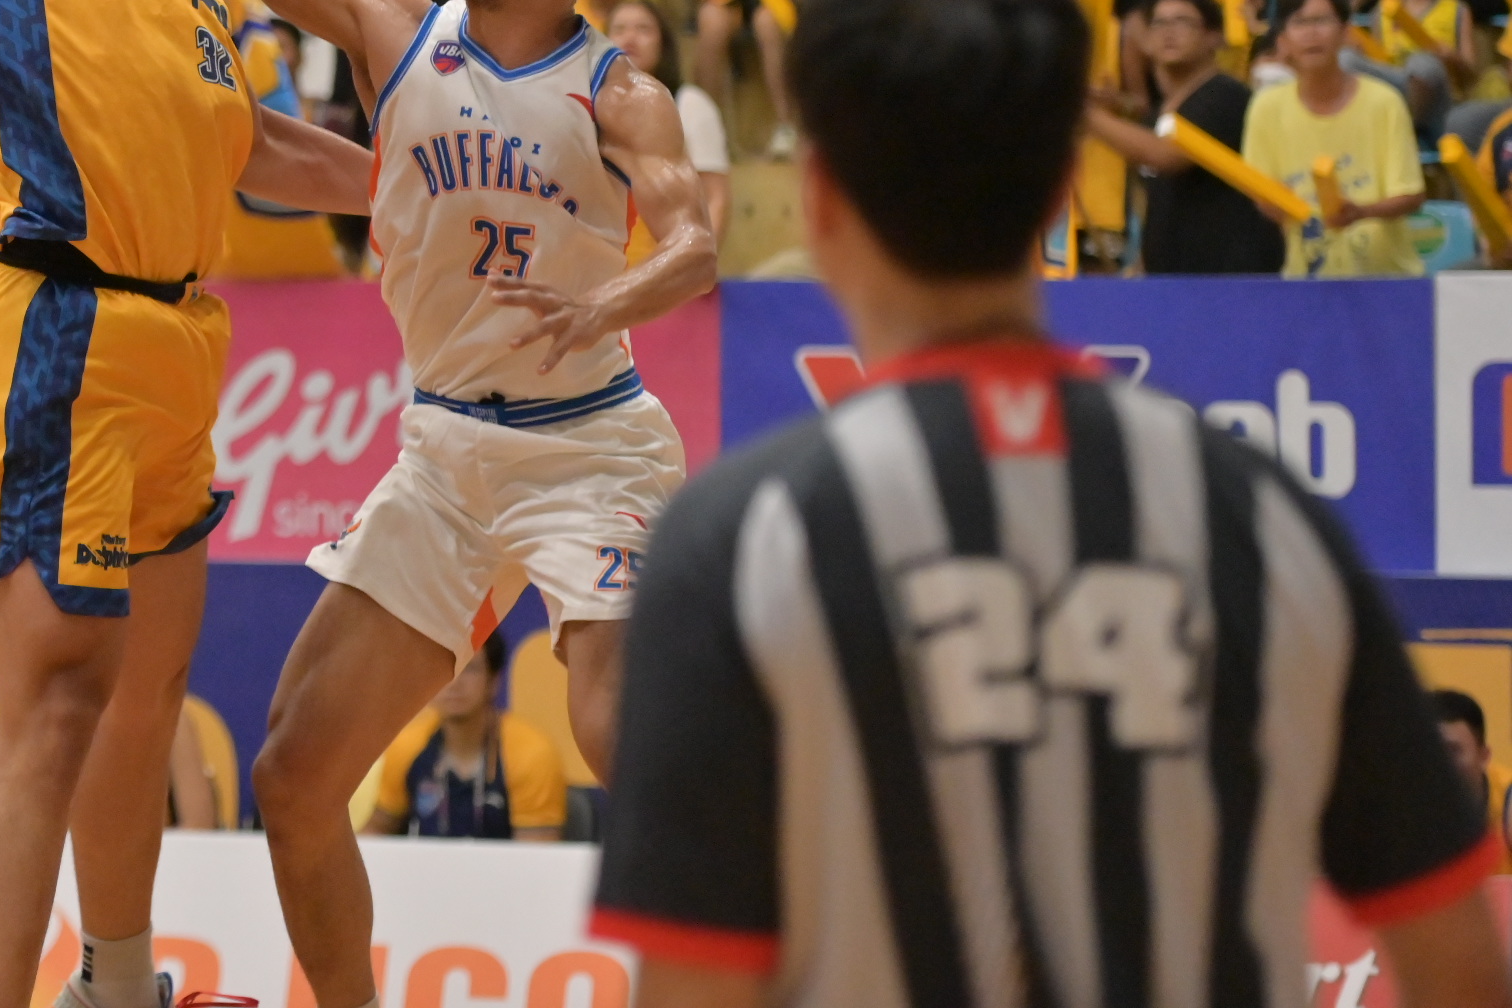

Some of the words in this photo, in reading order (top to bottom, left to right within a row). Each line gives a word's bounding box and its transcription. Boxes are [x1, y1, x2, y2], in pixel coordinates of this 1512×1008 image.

[195, 25, 237, 92] 32
[408, 128, 581, 222] BUFFAL
[469, 215, 536, 281] 25
[273, 492, 364, 538] sinc
[893, 554, 1210, 750] 24
